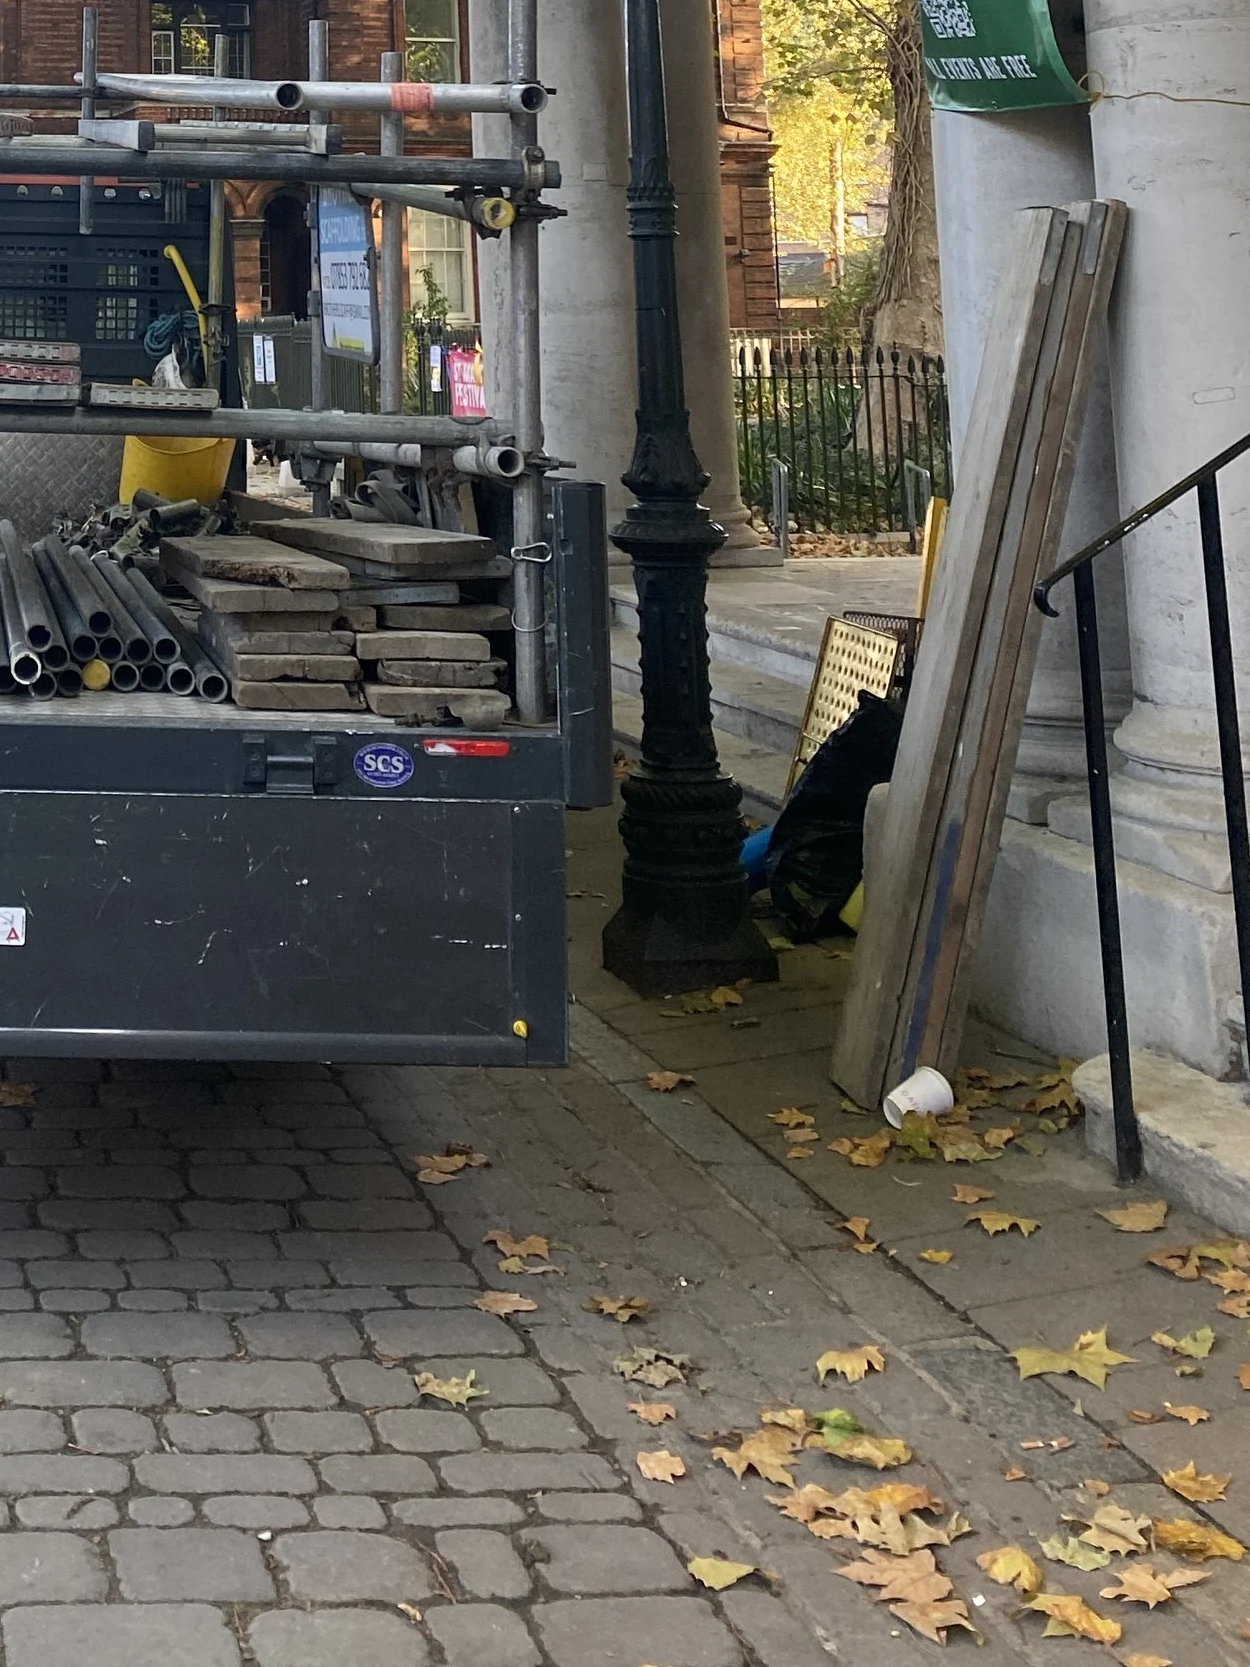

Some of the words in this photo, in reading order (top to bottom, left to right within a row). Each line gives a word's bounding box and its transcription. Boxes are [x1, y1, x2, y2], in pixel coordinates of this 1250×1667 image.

[940, 57, 982, 80] EVENTS
[979, 57, 1007, 79] ARE
[1001, 54, 1038, 79] FREE
[454, 383, 486, 409] FESTIVA
[363, 754, 405, 774] SCS
